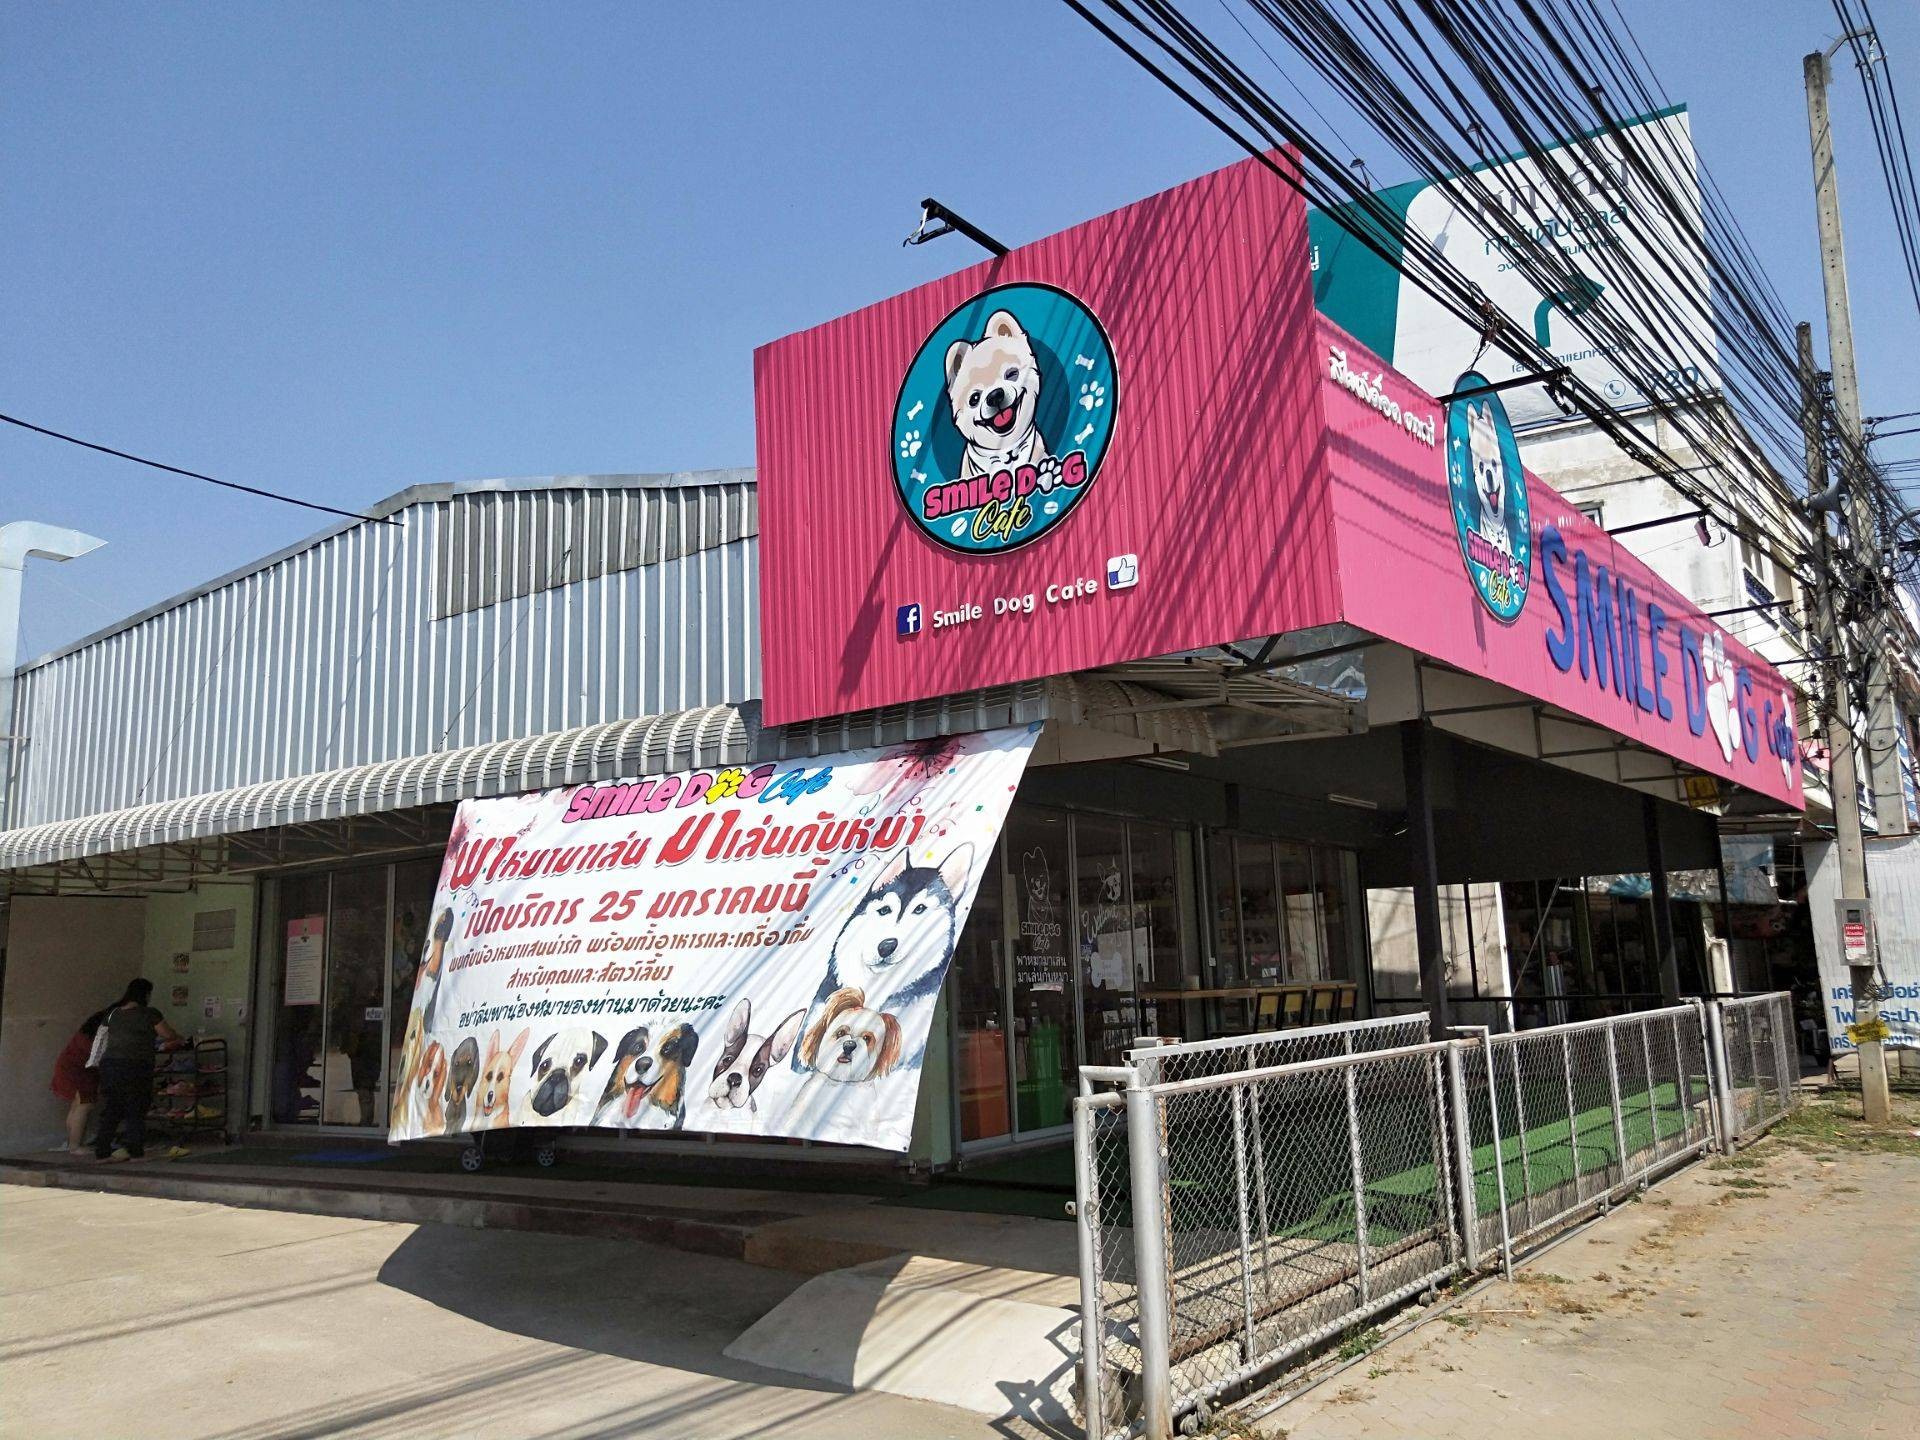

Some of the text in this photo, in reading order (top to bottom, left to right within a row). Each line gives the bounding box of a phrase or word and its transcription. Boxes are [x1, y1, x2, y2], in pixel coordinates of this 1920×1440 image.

[933, 603, 983, 629] Smile
[994, 593, 1035, 616] Dog
[1046, 577, 1099, 604] Cafe
[1540, 525, 1673, 721] SMILE
[464, 857, 831, 940] เปิดบริการ 25 มกราคมนี้
